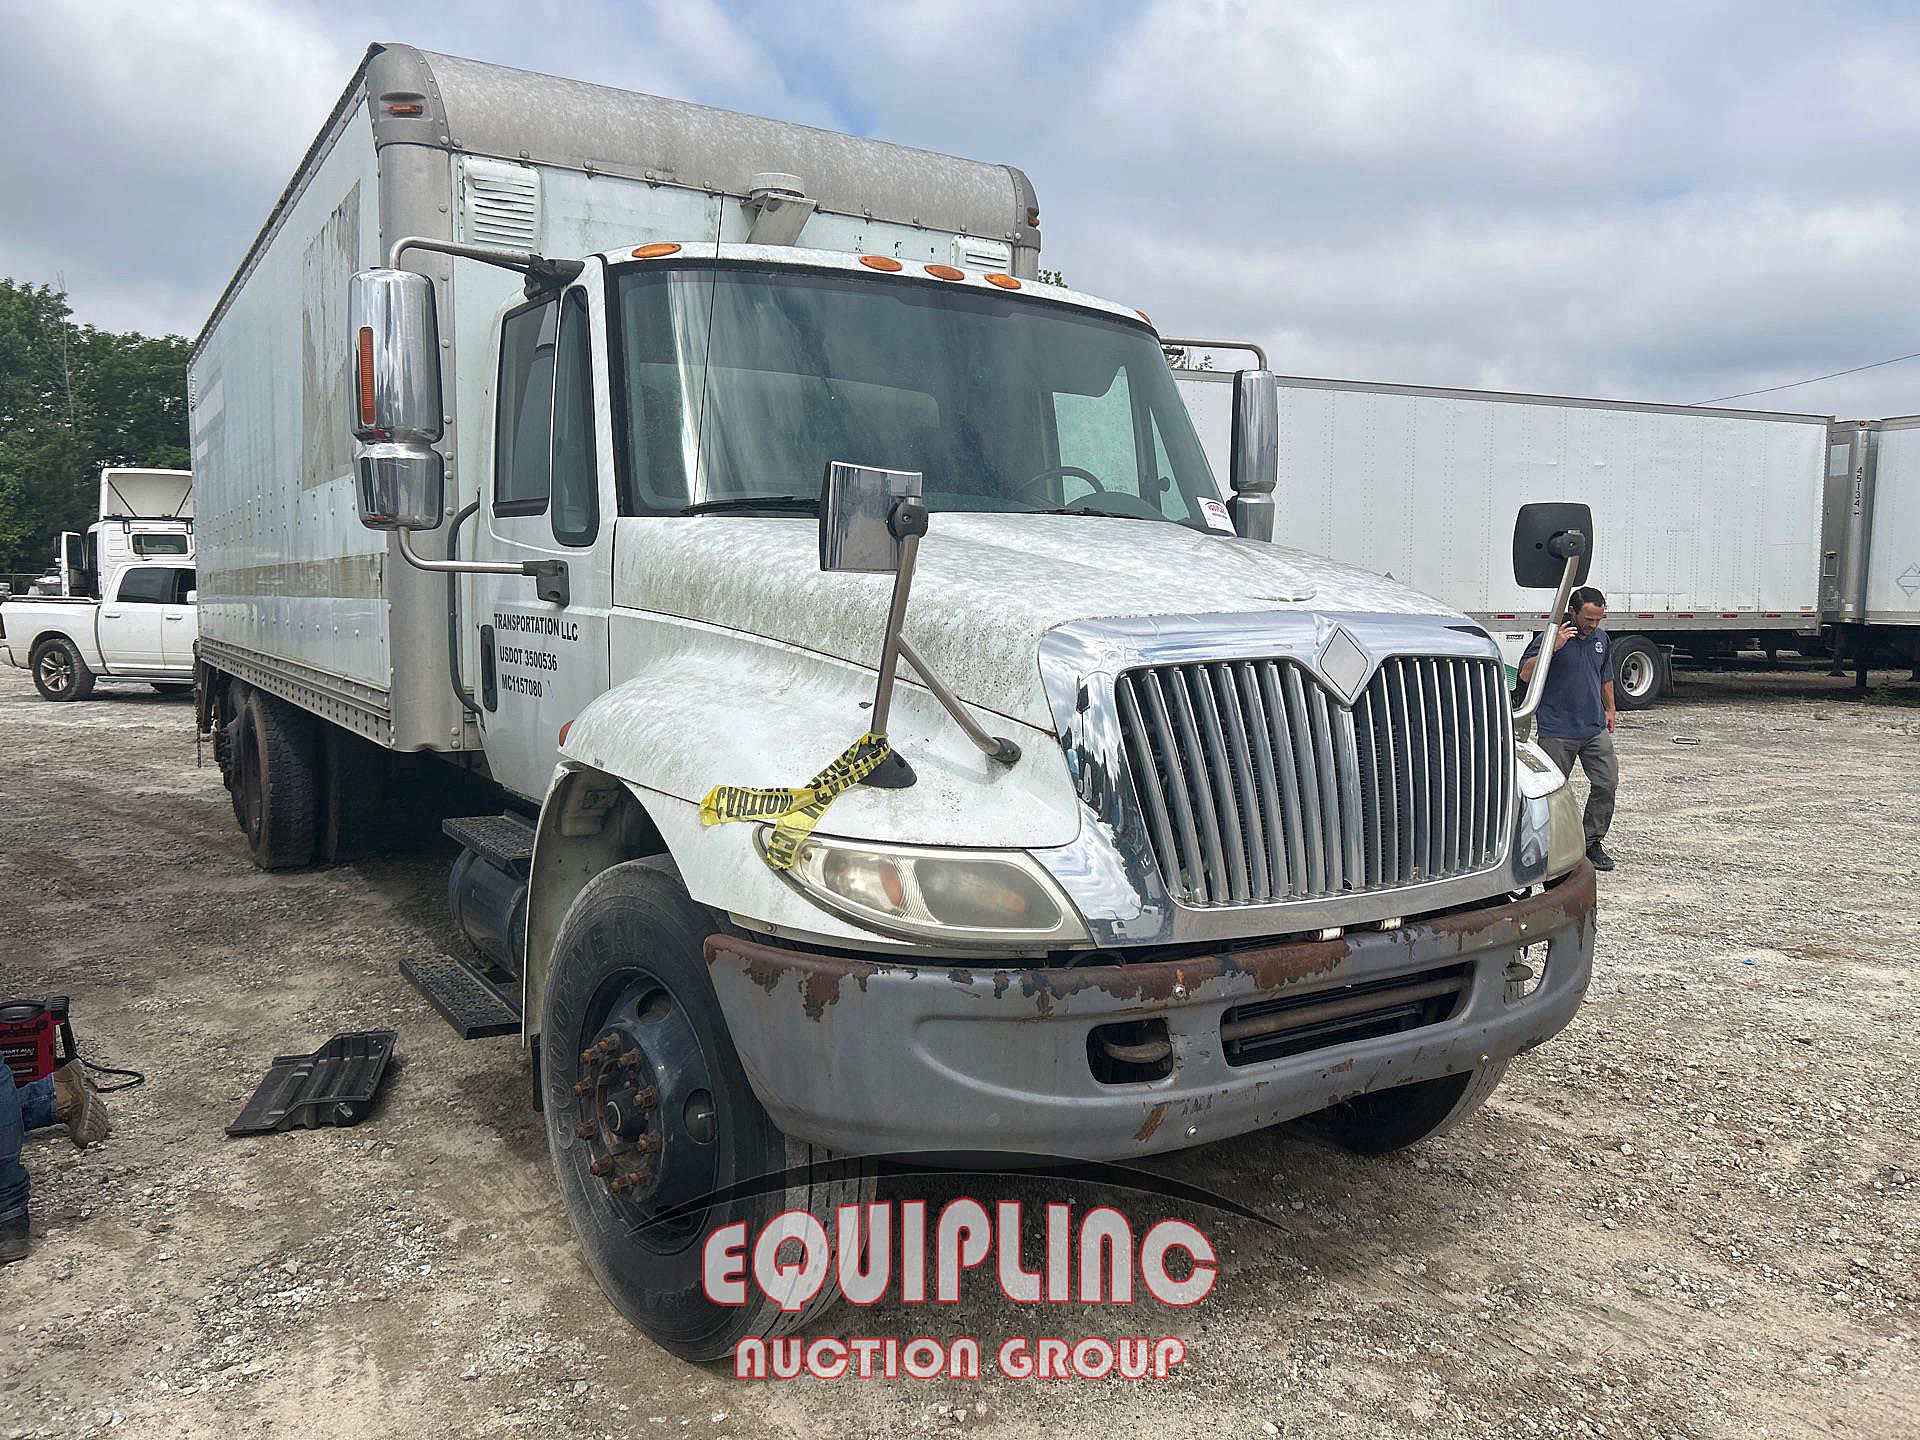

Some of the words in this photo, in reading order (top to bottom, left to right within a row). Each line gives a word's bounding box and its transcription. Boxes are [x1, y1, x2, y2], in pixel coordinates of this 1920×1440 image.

[494, 613, 560, 636] TRANSPORTATION
[561, 621, 578, 641] LLC
[500, 645, 523, 666] USDOT
[525, 650, 558, 671] 3500536
[501, 673, 542, 698] MC1157080
